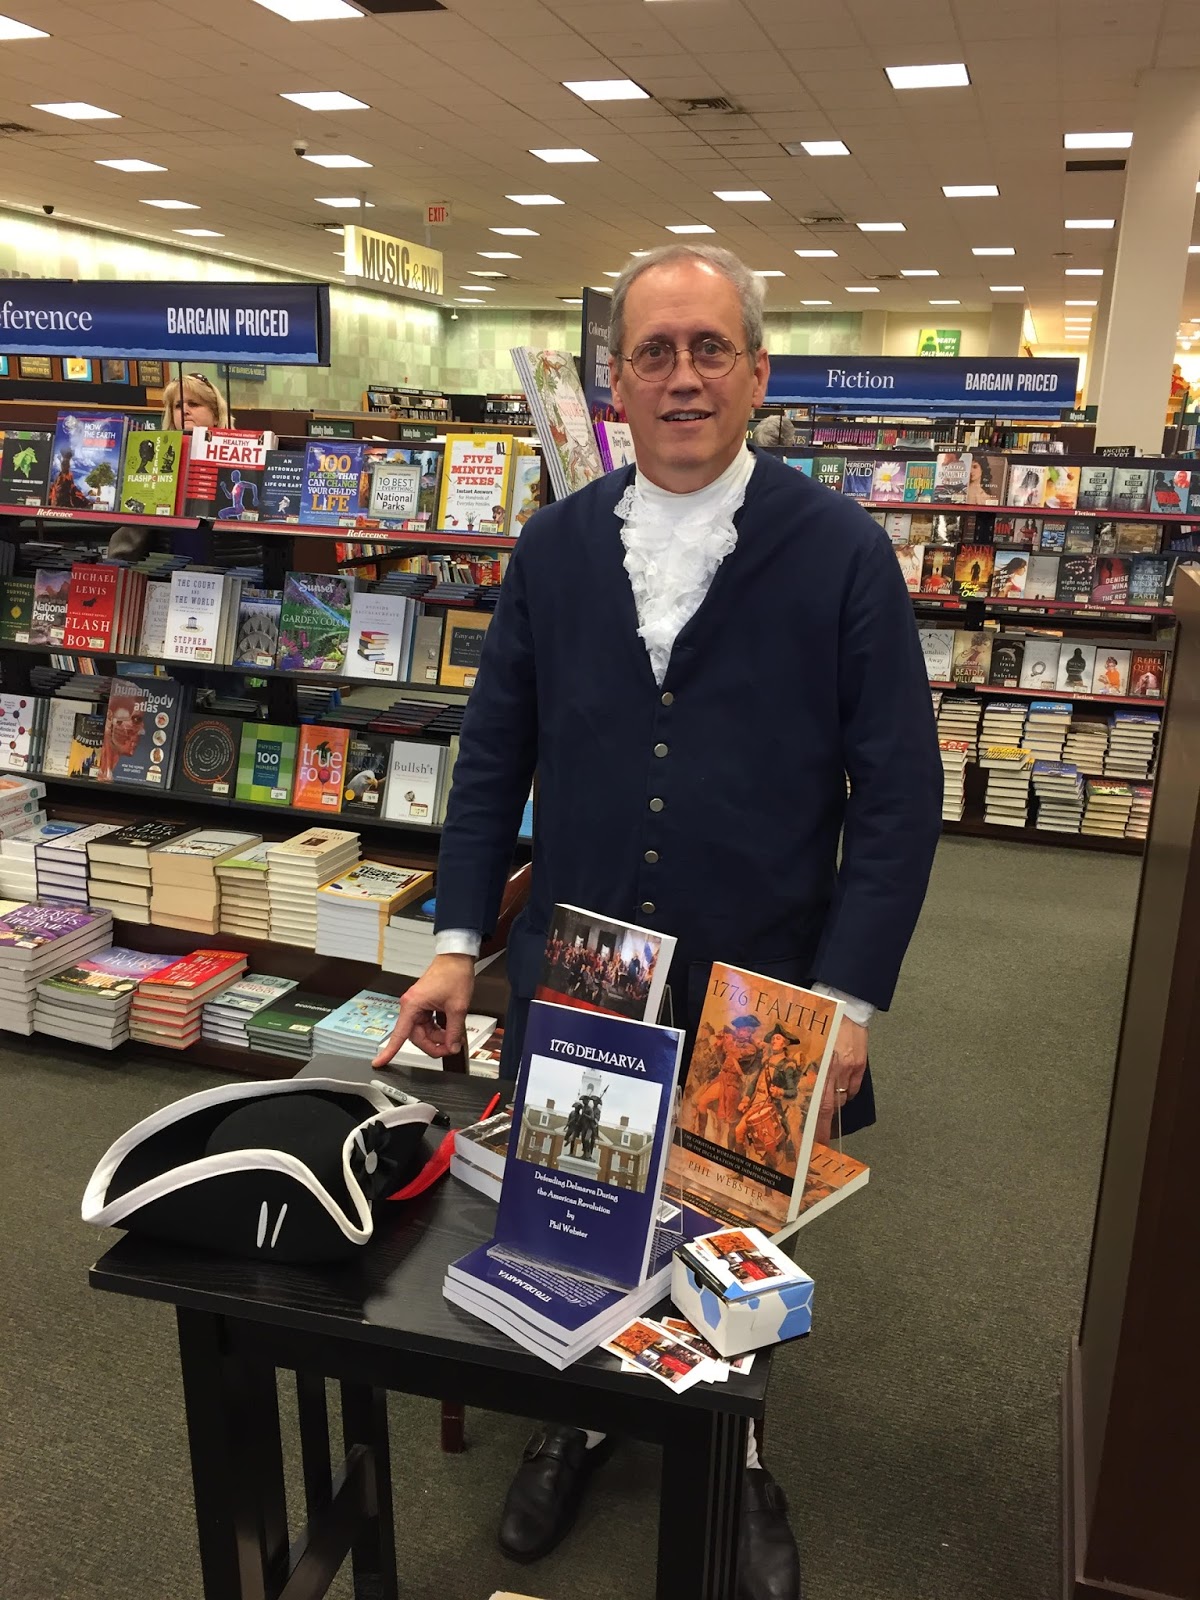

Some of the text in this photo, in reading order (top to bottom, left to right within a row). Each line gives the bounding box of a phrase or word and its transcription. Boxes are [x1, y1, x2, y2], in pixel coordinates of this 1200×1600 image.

[428, 207, 445, 222] EXIT
[361, 234, 440, 294] MUSIC & DVD
[0, 300, 93, 331] ference
[167, 307, 289, 337] BARGAIN PRICED
[827, 369, 895, 389] Fiction
[965, 373, 1058, 392] BARGAIN PRICED
[96, 431, 116, 439] EARTH
[223, 439, 250, 447] HEALTHY
[206, 445, 262, 463] HEART
[463, 455, 493, 463] FIVE
[318, 454, 352, 472] 100
[821, 464, 838, 473] ONE
[309, 472, 337, 480] PLACES
[451, 466, 503, 475] MINUTE
[846, 468, 872, 477] WILD
[308, 479, 357, 488] CAN CHANGE
[379, 477, 413, 487] 10 BEST
[457, 477, 494, 485] FIXES
[818, 474, 840, 483] STEP
[308, 486, 357, 496] YOUR CHILD'S
[311, 494, 350, 512] LIFE
[376, 493, 413, 503] National
[382, 502, 405, 511] Parks
[36, 509, 73, 518] Reference
[347, 529, 388, 539] Reference
[71, 572, 116, 583] MICHAEL
[1105, 575, 1129, 585] DENISE
[1134, 574, 1162, 582] SECRET
[178, 579, 216, 589] THE COURT
[299, 580, 335, 593] Sunset
[1111, 582, 1128, 591] MINA
[76, 586, 107, 595] LEWIS
[175, 595, 215, 606] THE WORLD
[34, 601, 68, 613] National
[32, 611, 55, 621] Parks
[282, 614, 318, 625] GARDEN
[65, 617, 110, 632] FLASH
[67, 635, 92, 647] BOY
[173, 636, 207, 645] STEPHEN
[454, 632, 466, 641] Easy
[175, 645, 193, 654] BREY
[1137, 657, 1161, 665] REBEL
[1133, 664, 1163, 672] QUEEN
[115, 684, 174, 708] human body
[133, 700, 158, 713] atlas
[257, 752, 279, 764] 100
[303, 743, 342, 769] true
[105, 957, 157, 971] HOUSE
[237, 984, 276, 995] SCHOOL
[295, 1002, 331, 1013] economics
[713, 979, 830, 1036] 1776 FAITH
[550, 1038, 646, 1072] 1776 DELMARVA
[692, 1137, 717, 1151] CHRISTIAN
[716, 1147, 745, 1165] WORLDVIEW
[761, 1167, 782, 1181] SIGNERS
[701, 1148, 735, 1169] DECLARATION
[741, 1166, 776, 1186] INDEPENDENCE
[534, 1170, 619, 1203] Defending Delmarva During
[688, 1160, 764, 1202] PHIL WEBSTER
[537, 1187, 611, 1215] the American Revolution
[566, 1210, 575, 1221] by
[549, 1219, 588, 1239] Phil Webster
